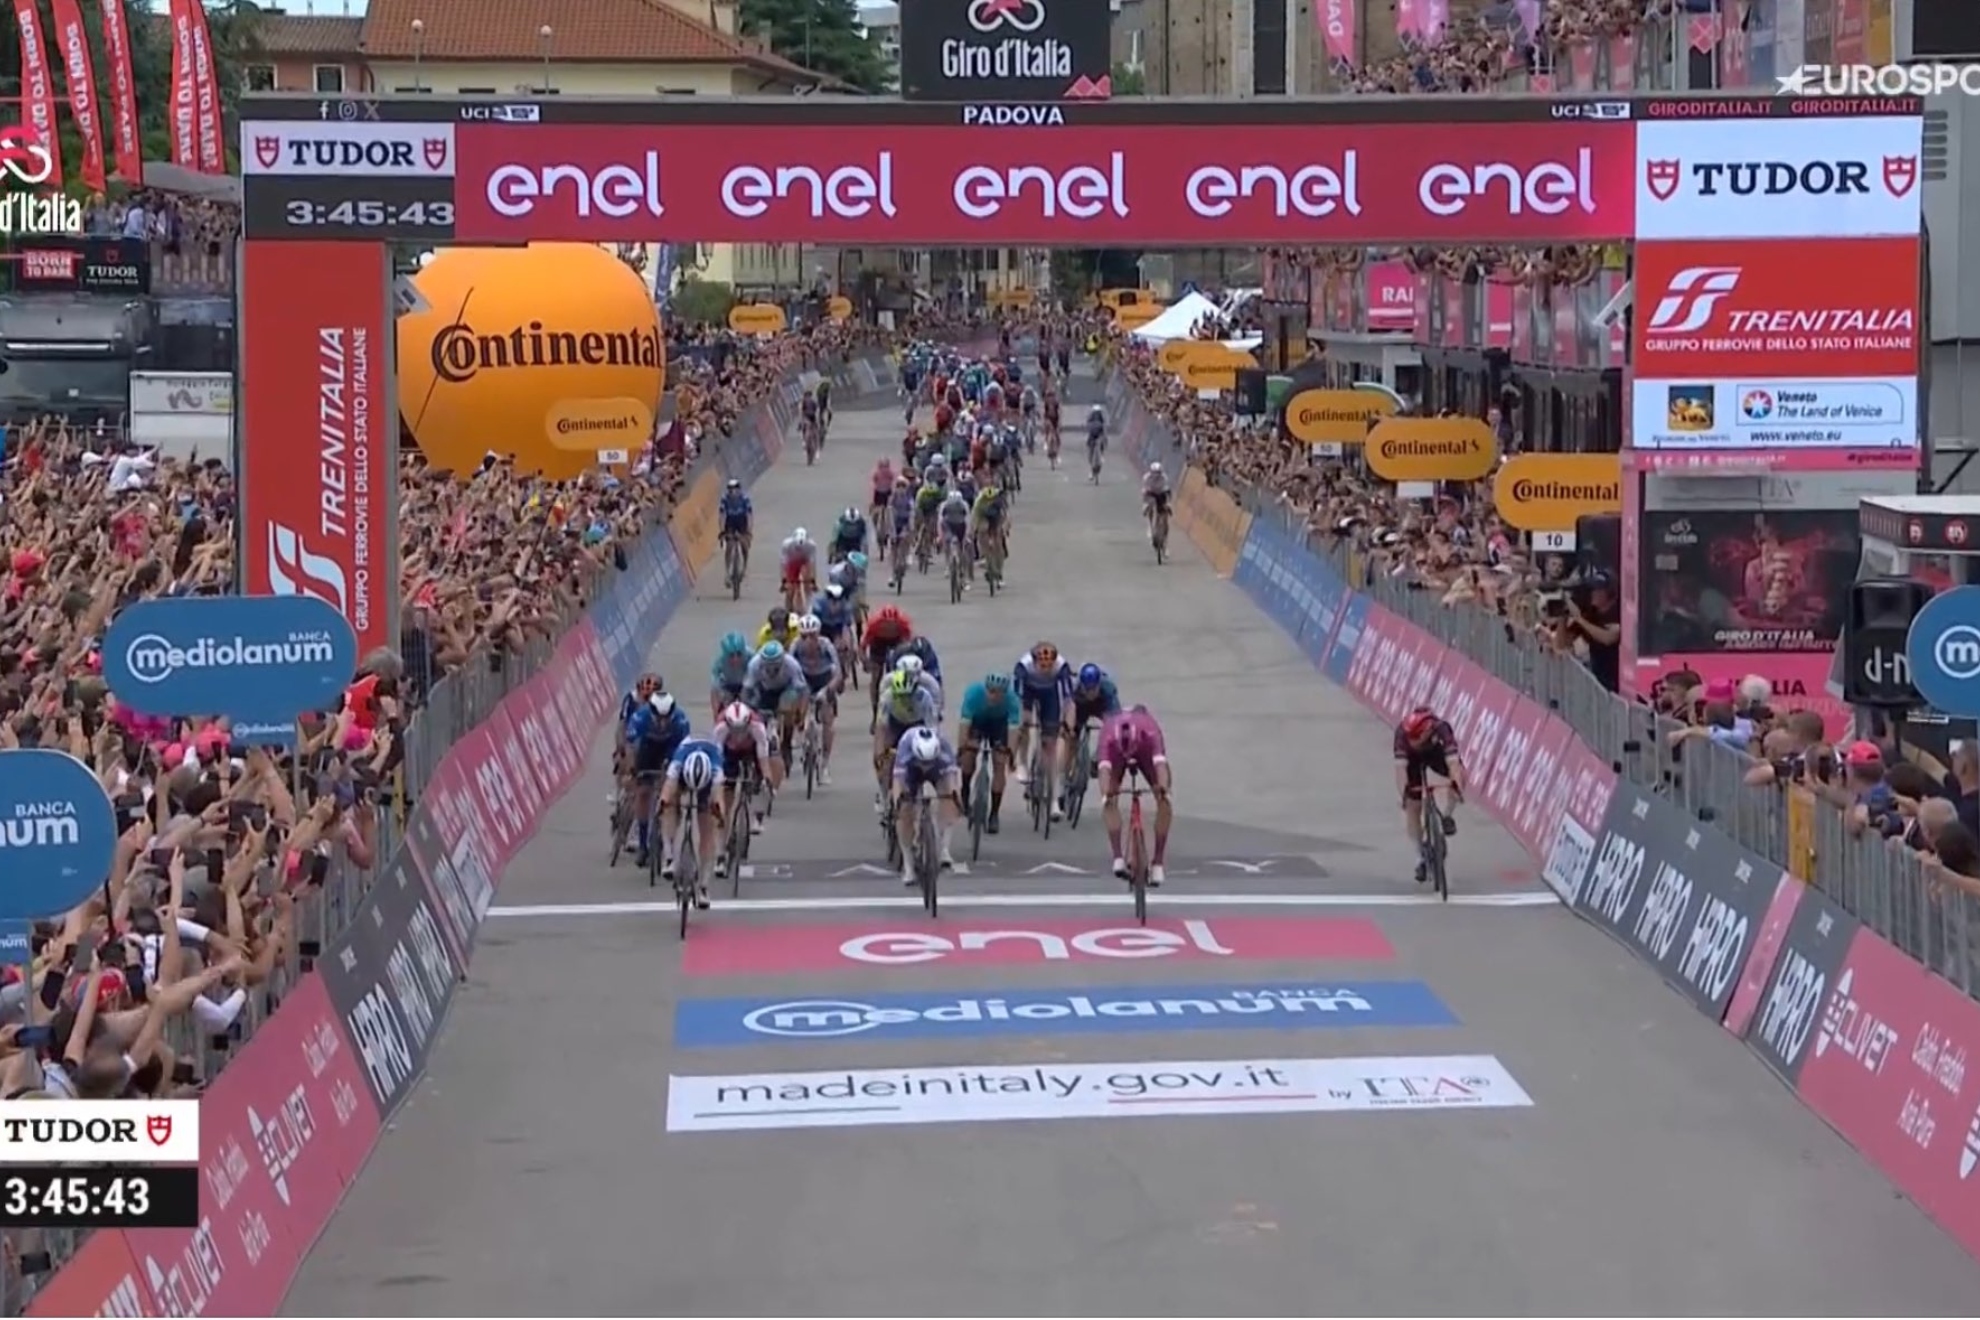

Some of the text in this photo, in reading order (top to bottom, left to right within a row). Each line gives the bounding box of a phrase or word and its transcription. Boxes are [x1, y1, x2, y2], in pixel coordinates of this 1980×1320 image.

[942, 40, 1071, 78] Giro d'Italia
[31, 70, 45, 99] TO
[74, 80, 88, 110] TO
[178, 75, 193, 104] TO
[200, 84, 212, 111] TO
[461, 107, 489, 119] UCI
[963, 106, 1064, 125] PADOVA
[1551, 105, 1580, 118] UCI
[1649, 98, 1916, 117] GIRODITALIA.IT GIRODITALIA.IT
[288, 140, 416, 167] TUDOR
[487, 150, 664, 216] enel
[721, 151, 897, 217] enel
[954, 151, 1129, 217] enel
[1186, 149, 1361, 216] enel
[1419, 147, 1596, 215] enel
[1693, 161, 1869, 196] TUDOR
[287, 200, 455, 227] 3:45:43
[26, 251, 72, 266] BORN
[28, 266, 72, 277] TO DARE
[87, 265, 138, 278] TUDOR
[1727, 309, 1913, 333] TRENITALIA
[431, 321, 664, 383] Continental
[1646, 336, 1912, 352] GRUPPO FERROVIE DELLO STATO ITALIANE
[1777, 390, 1817, 403] Veneto
[1777, 405, 1883, 418] The Land of Venice
[320, 327, 346, 536] TRENITALIA
[556, 416, 628, 435] Continental
[1750, 430, 1841, 443] www.veneto.eu
[1380, 438, 1468, 460] Continental
[354, 327, 369, 630] GRUPPO FERROVIE DELLO STATO ITALIANE
[1513, 478, 1619, 502] Continental
[1546, 533, 1564, 548] 10
[289, 630, 332, 643] BANCA
[1714, 629, 1815, 642] GIRO D'ITALIA
[130, 635, 334, 674] mediolanum
[15, 801, 76, 818] BANCA
[839, 919, 1236, 965] enel
[748, 995, 1372, 1034] mediolanum
[717, 1065, 1288, 1103] madeinitaly.gov.it
[1329, 1077, 1474, 1102] by ITA
